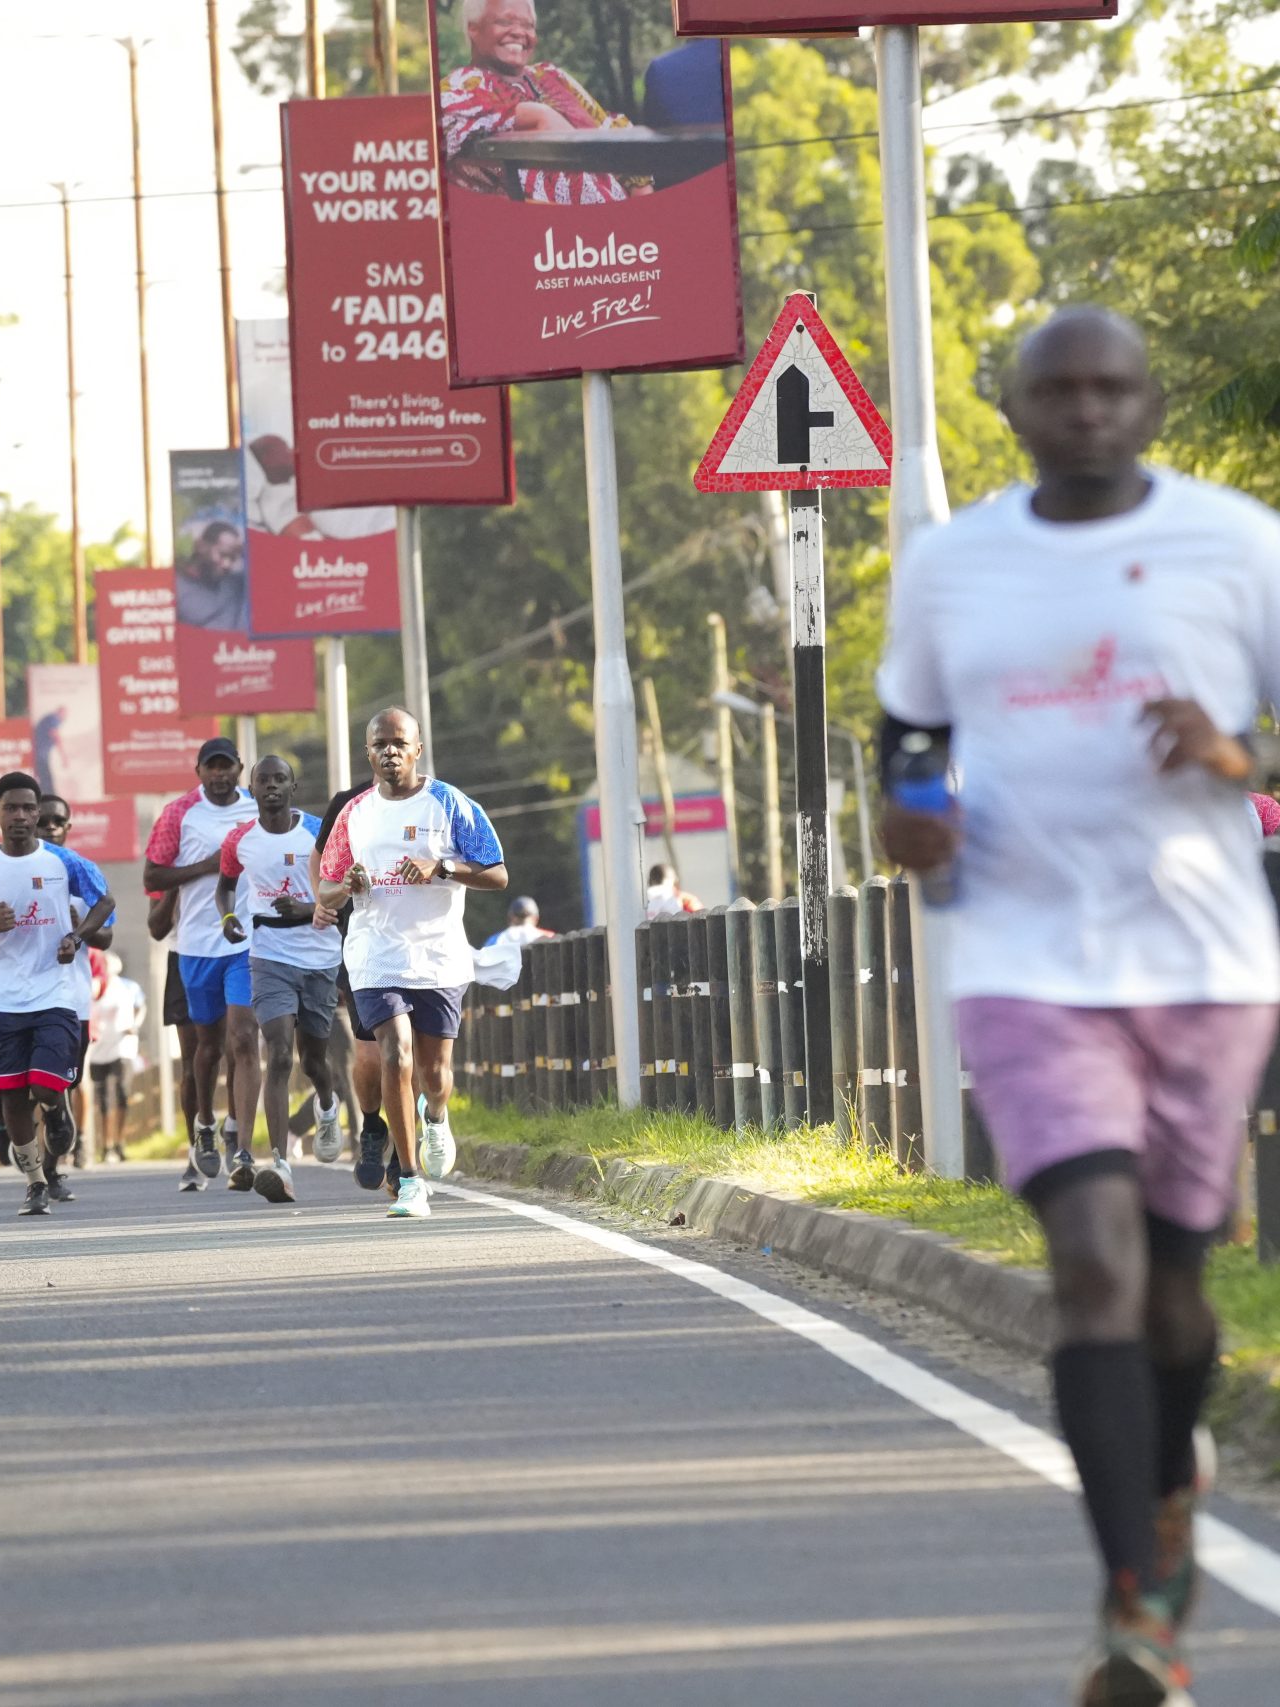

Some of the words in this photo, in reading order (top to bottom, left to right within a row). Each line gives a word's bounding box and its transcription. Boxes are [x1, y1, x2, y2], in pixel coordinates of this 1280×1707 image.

[352, 139, 429, 164] MAKE
[300, 170, 376, 195] YOUR
[312, 198, 399, 223] WORK
[534, 226, 659, 272] Jubilee
[366, 261, 424, 288] SMS
[535, 277, 570, 295] ASSET
[573, 269, 662, 292] MANAGEMENT
[541, 310, 588, 339] Live
[591, 284, 652, 324] Free!
[321, 341, 346, 363] to
[354, 329, 449, 362] 2446
[348, 394, 399, 410] There's
[402, 393, 444, 411] living,
[308, 413, 340, 429] and
[344, 412, 396, 428] there's
[400, 411, 445, 430] living
[448, 409, 486, 425] free.
[292, 549, 369, 579] Jubilee
